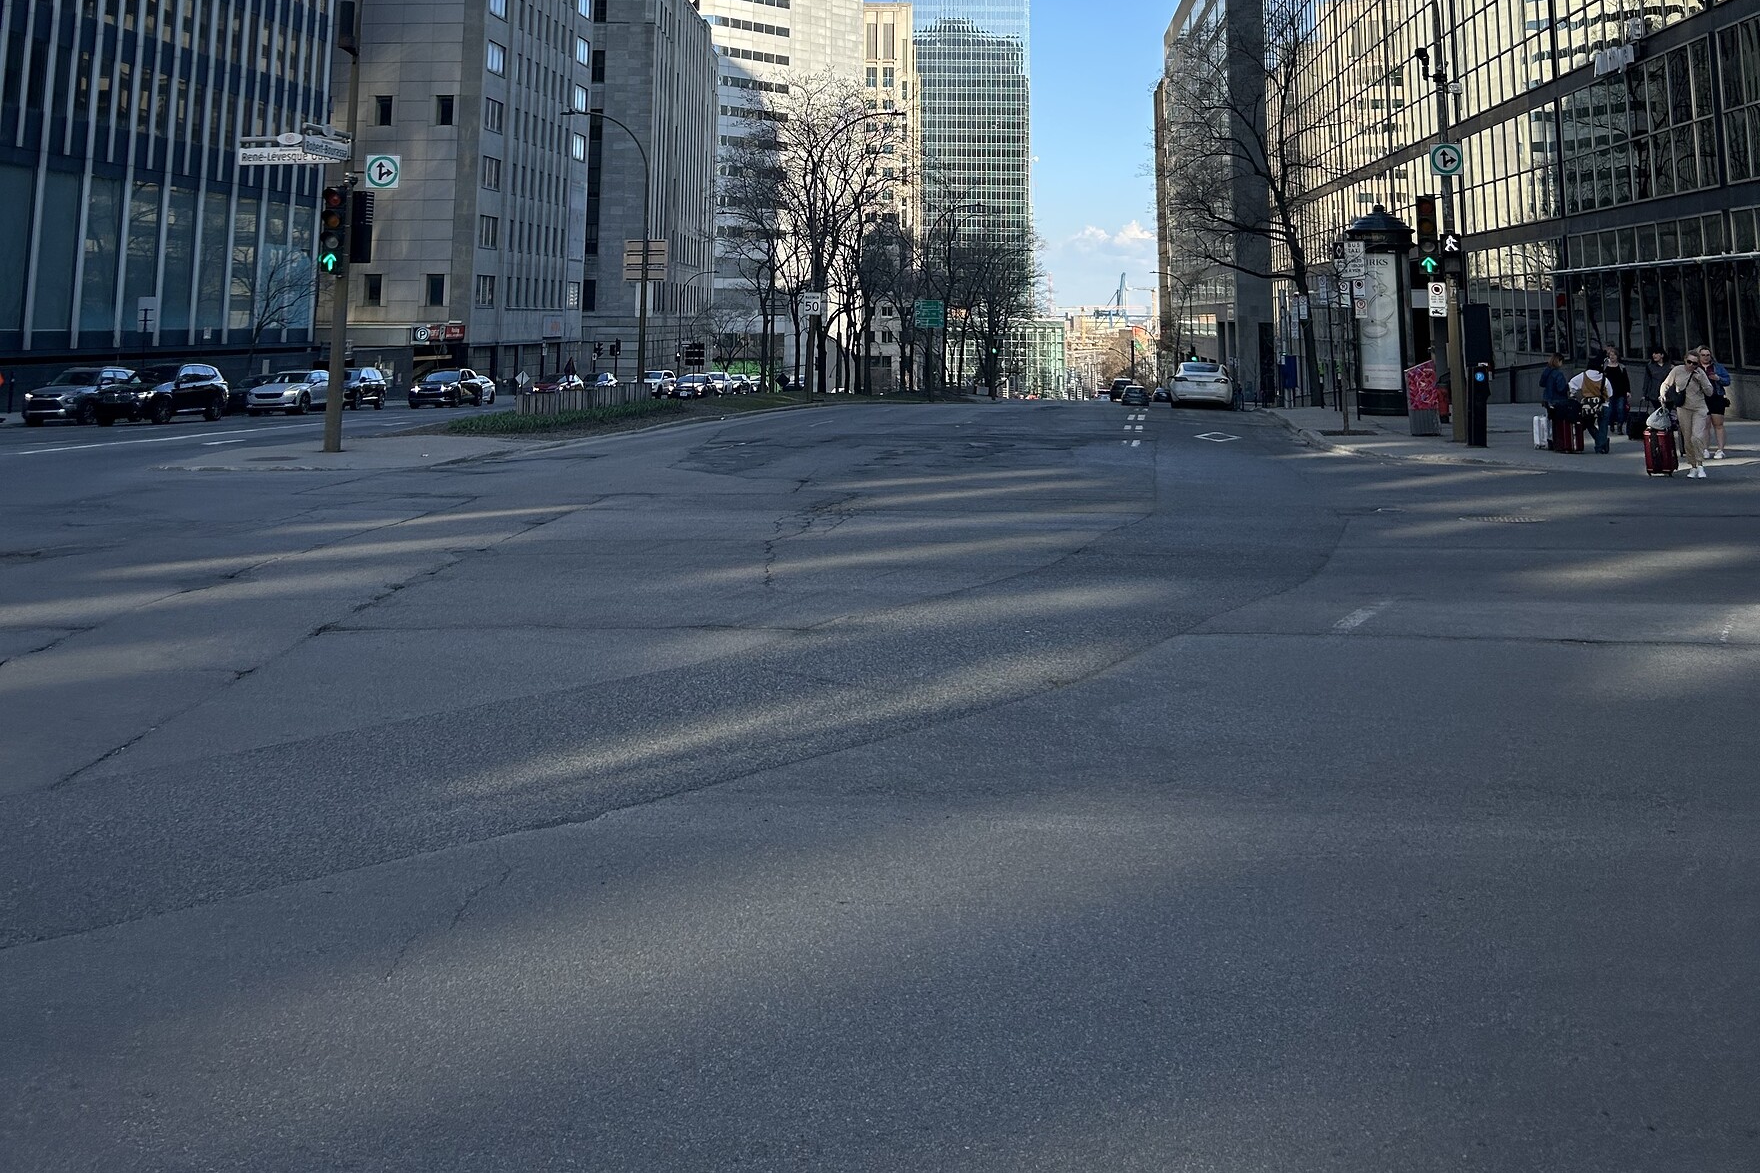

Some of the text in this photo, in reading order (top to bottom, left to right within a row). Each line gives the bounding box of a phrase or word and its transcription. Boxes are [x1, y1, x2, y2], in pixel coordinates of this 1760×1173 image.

[242, 152, 307, 163] René-Lévesque
[1365, 258, 1388, 266] IRKS
[805, 301, 819, 312] 50
